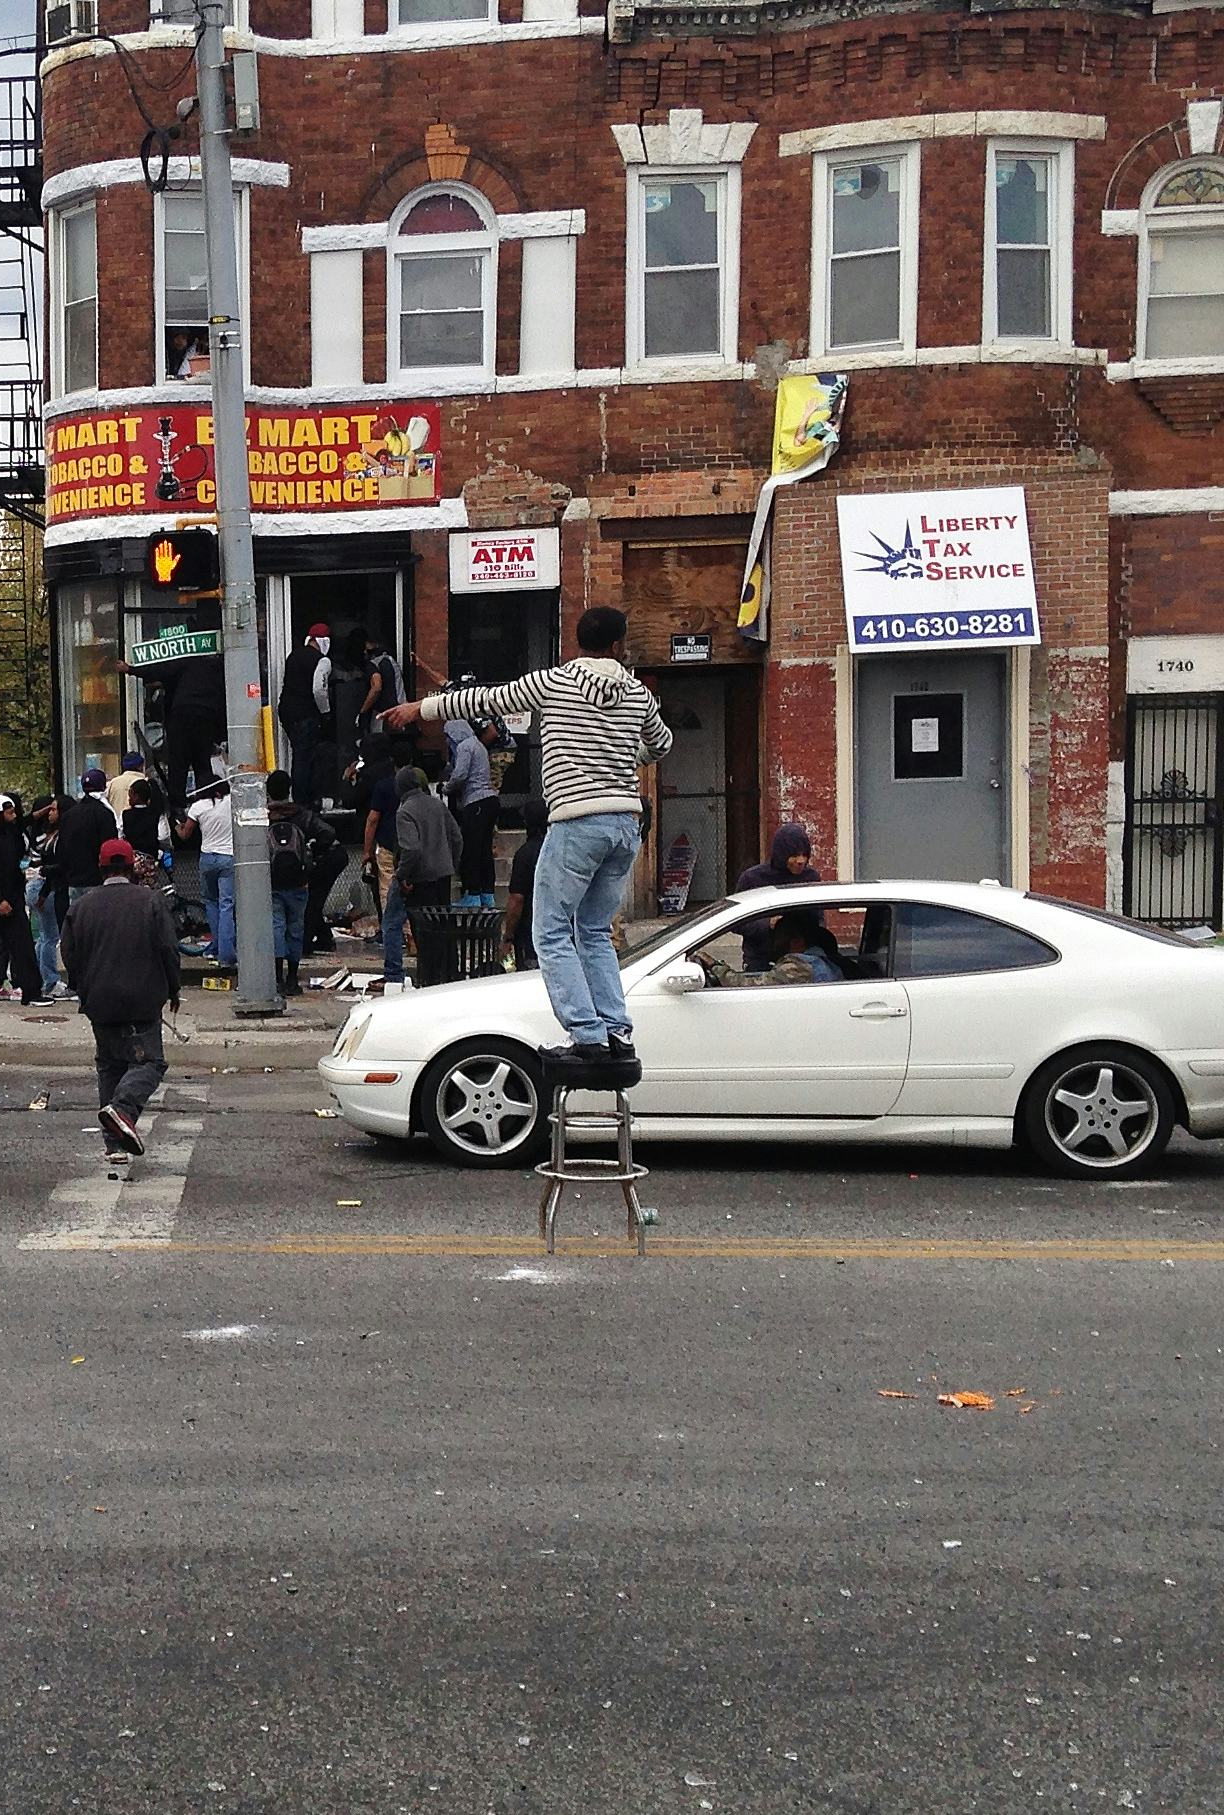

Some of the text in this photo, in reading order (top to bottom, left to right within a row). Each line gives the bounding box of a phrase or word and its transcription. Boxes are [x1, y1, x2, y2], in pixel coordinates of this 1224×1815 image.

[57, 417, 143, 452] MART
[258, 415, 378, 447] MART
[129, 455, 150, 475] &
[249, 450, 368, 475] BACCO &
[49, 482, 146, 516] NVENIENCE
[196, 478, 379, 505] CVENIENCE
[920, 515, 1018, 533] LIBERTY
[472, 546, 534, 564] ATM
[922, 539, 972, 558] TAX
[926, 561, 1026, 581] SERVICE
[165, 625, 185, 637] 1800
[861, 613, 1027, 639] 410-630-8281
[149, 637, 197, 658] NORTH
[1158, 661, 1194, 672] 1740
